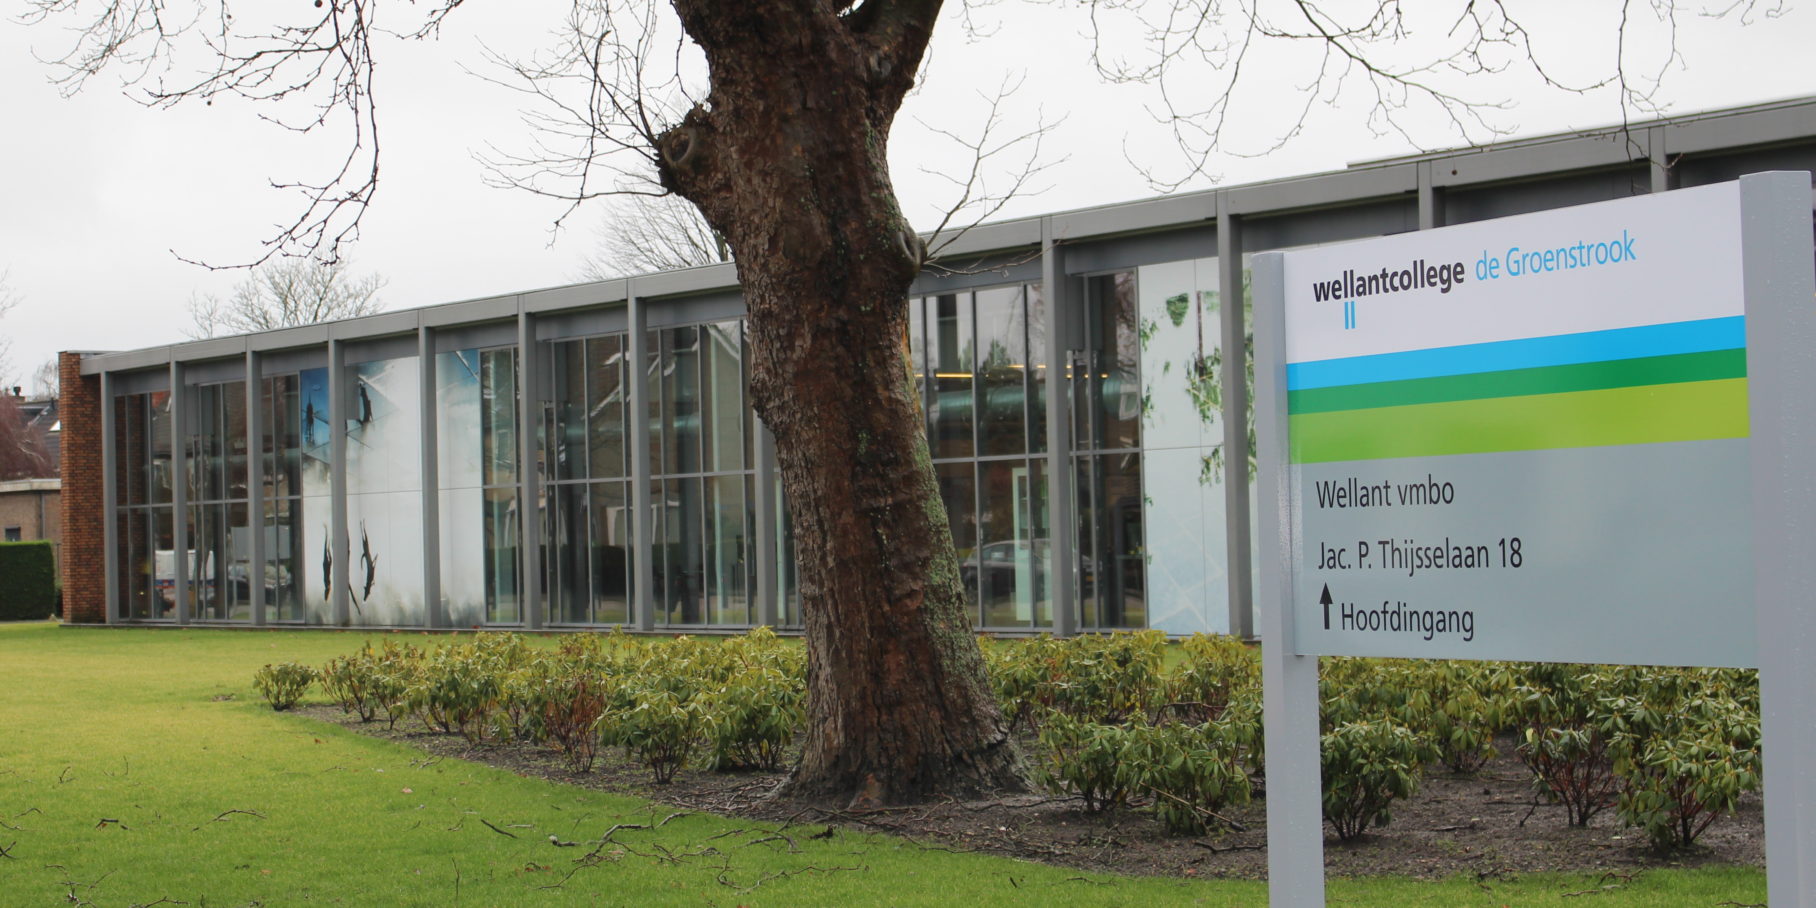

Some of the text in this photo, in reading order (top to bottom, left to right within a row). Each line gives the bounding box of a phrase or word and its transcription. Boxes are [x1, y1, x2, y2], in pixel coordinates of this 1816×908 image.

[1313, 229, 1637, 302] wellantcollege de Groenstrook
[1316, 474, 1455, 509] Wellant vmbo
[1318, 537, 1523, 577] Jac. P. Thijsselaan 18
[1341, 601, 1475, 642] Hoofdingang
